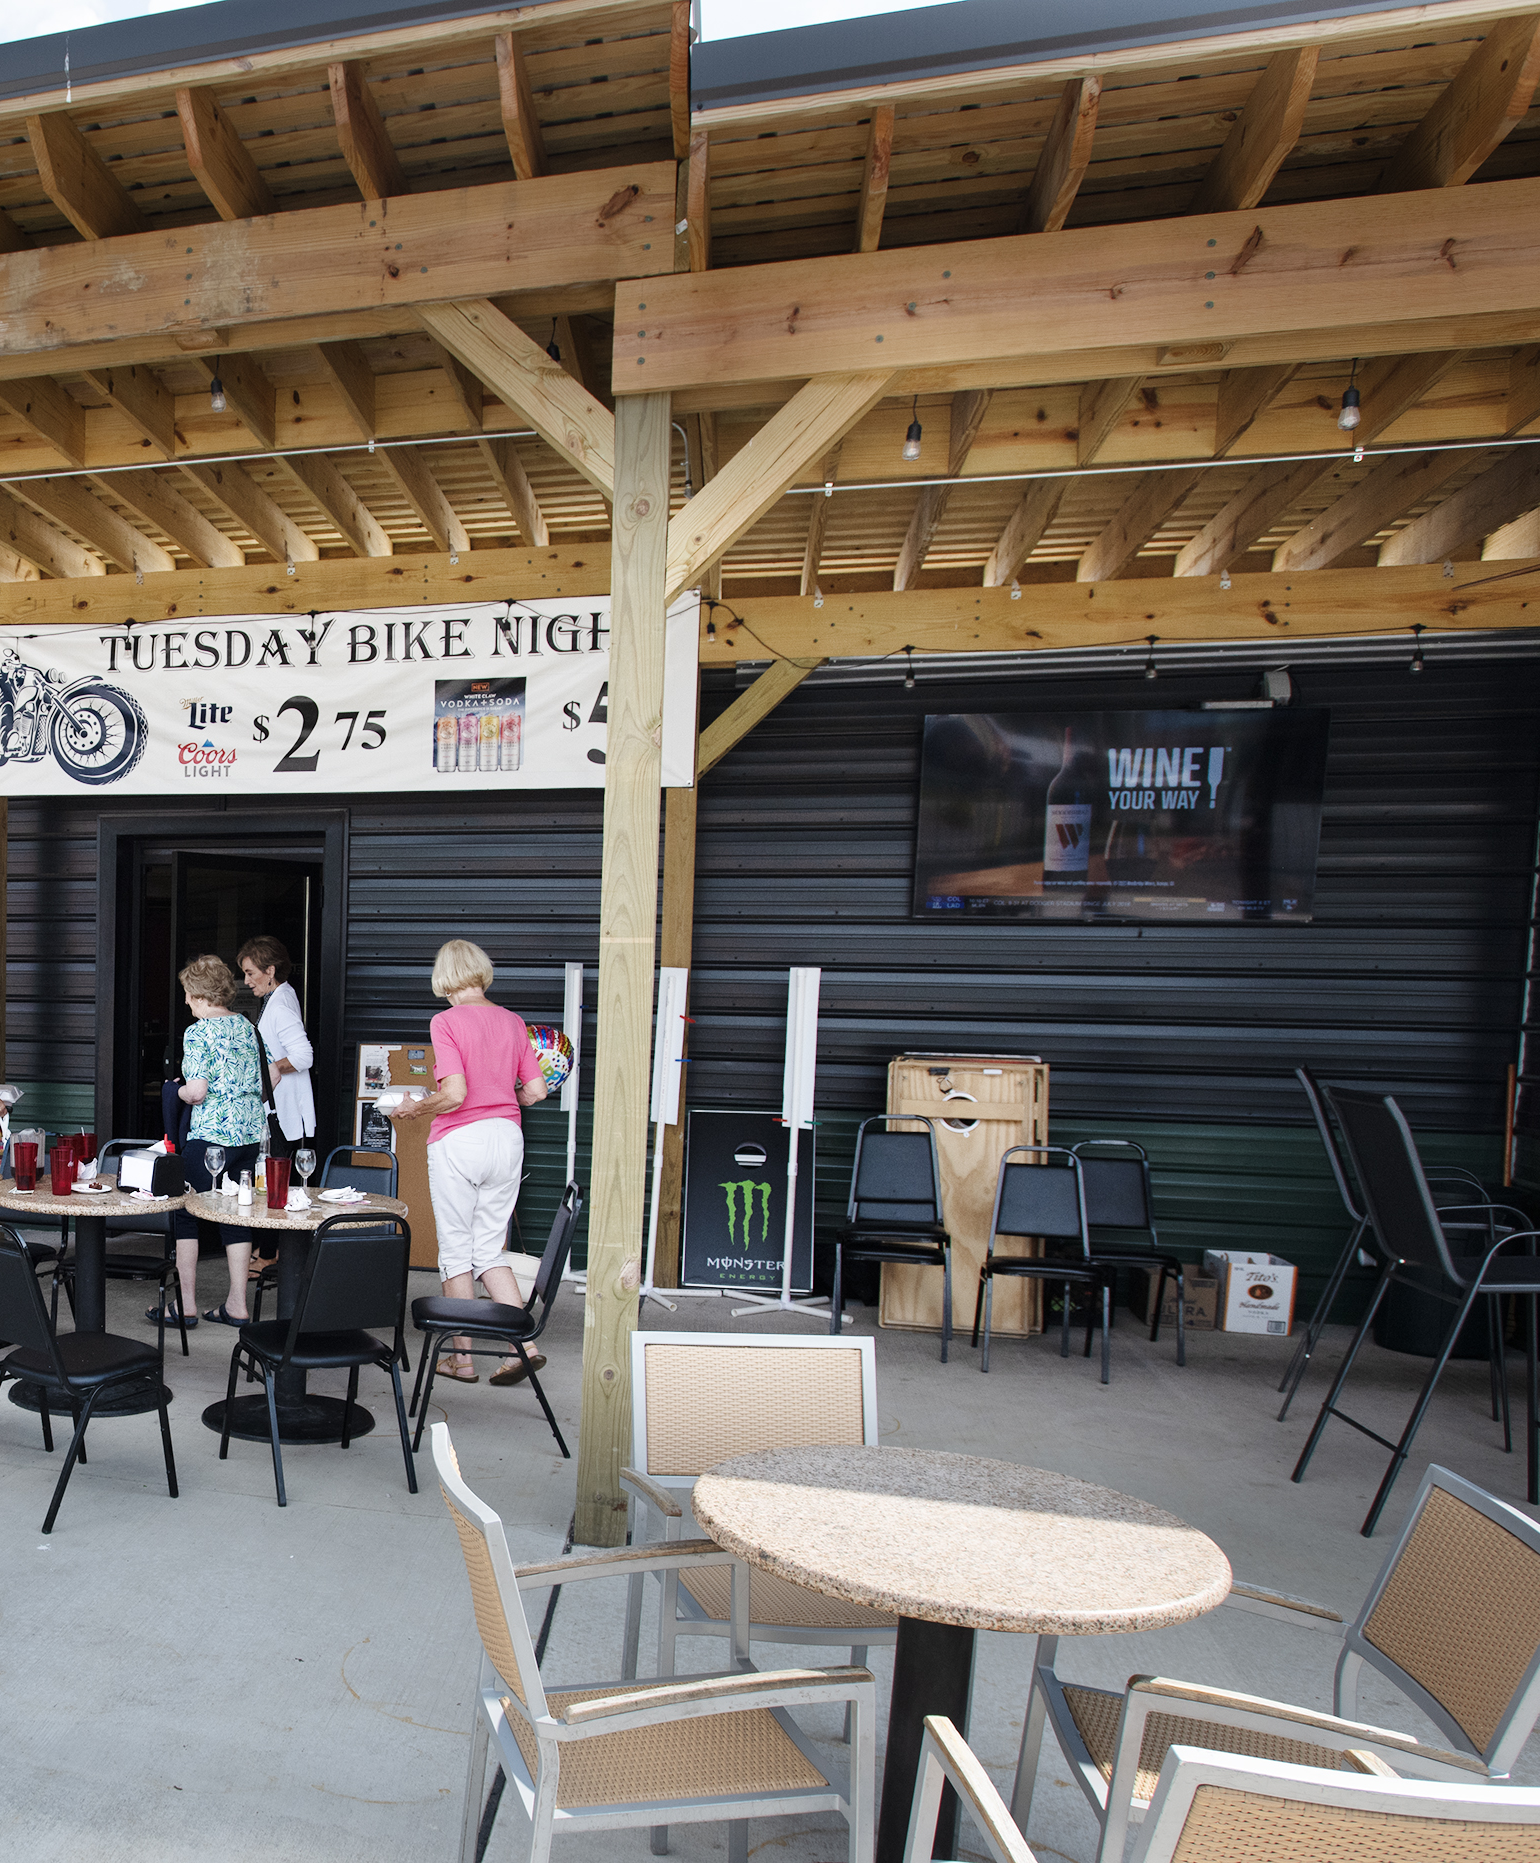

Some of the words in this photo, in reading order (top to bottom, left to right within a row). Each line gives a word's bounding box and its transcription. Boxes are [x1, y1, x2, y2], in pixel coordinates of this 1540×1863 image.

[100, 618, 336, 672] TUESDAY
[346, 617, 475, 664] BIKE
[490, 612, 610, 658] NIGH
[188, 703, 233, 730] Lite
[178, 742, 237, 764] Coors
[185, 766, 231, 777] LIGHT
[1108, 790, 1155, 809] YOUR
[1161, 790, 1199, 809] WAY
[706, 1256, 785, 1271] MONSTER
[720, 1273, 776, 1281] ENERGY
[1246, 1271, 1278, 1283] Tito's
[1239, 1301, 1280, 1311] Handmade
